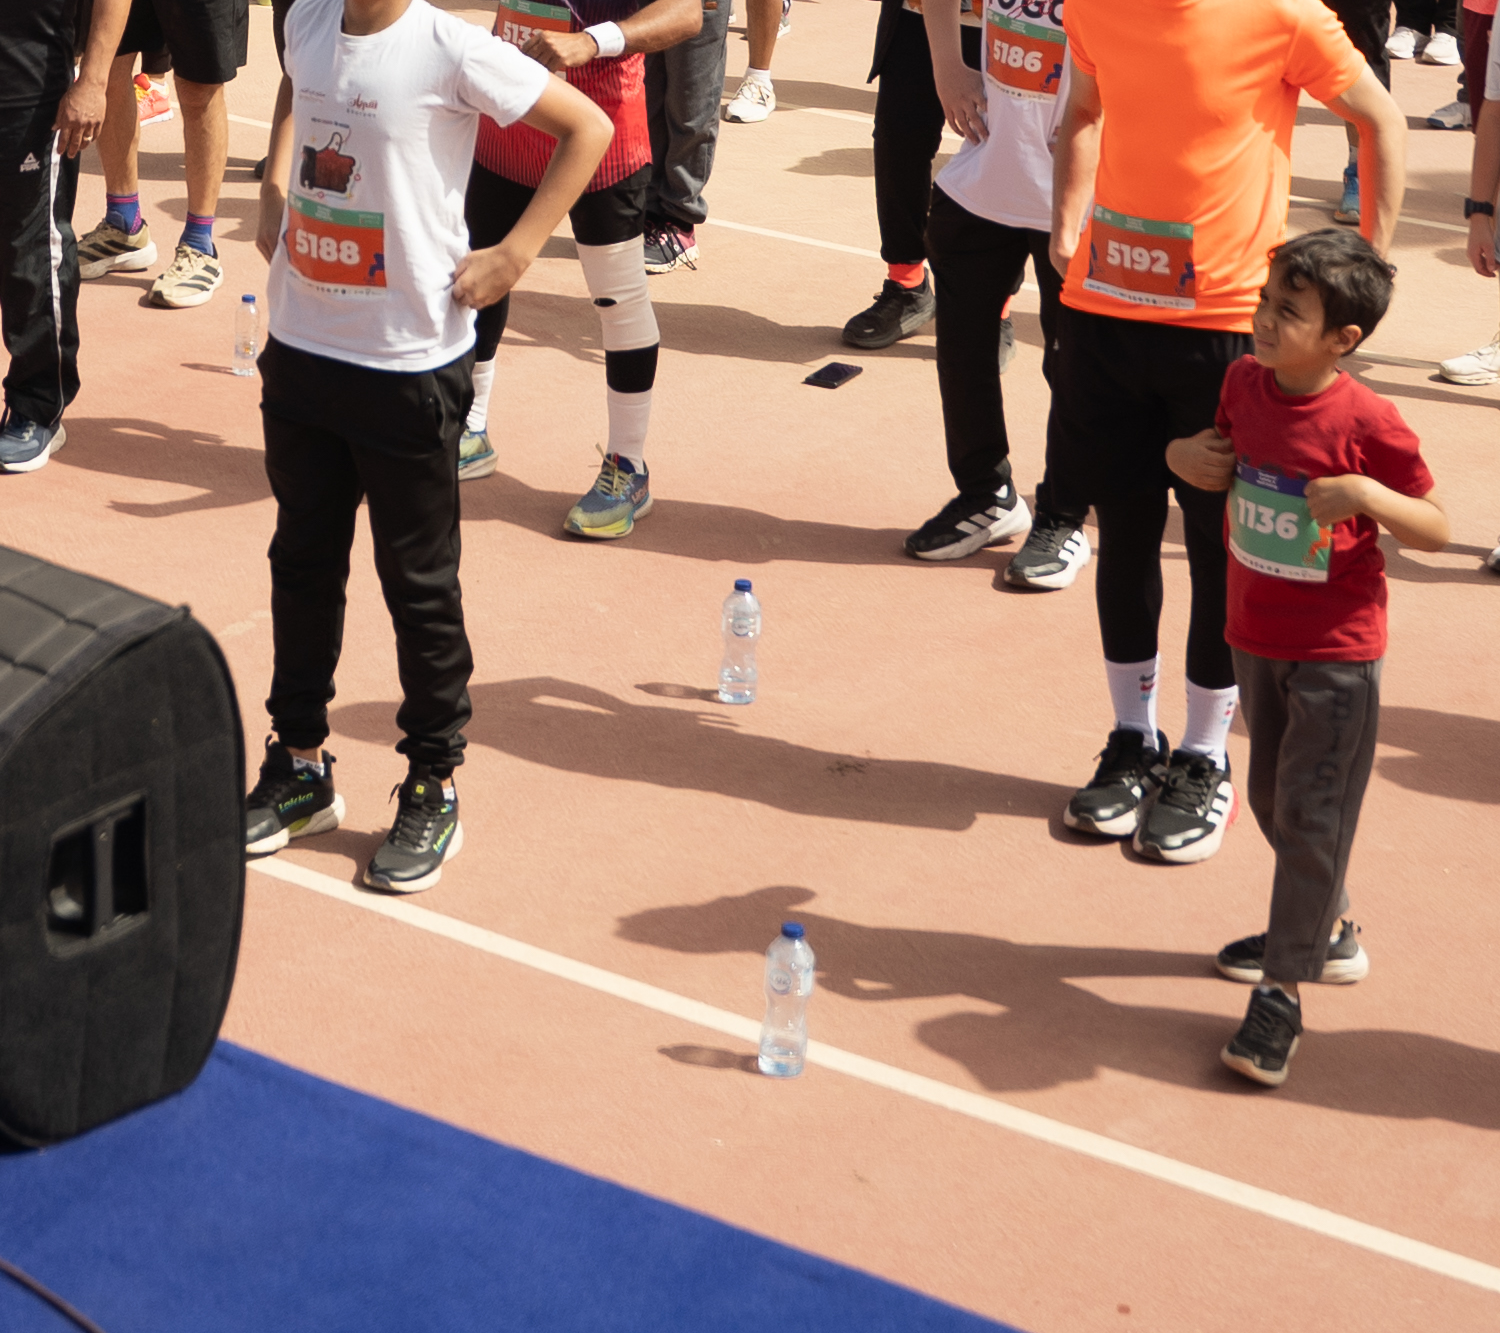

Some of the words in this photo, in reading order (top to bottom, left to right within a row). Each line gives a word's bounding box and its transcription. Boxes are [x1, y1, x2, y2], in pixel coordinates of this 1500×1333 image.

[993, 39, 1043, 73] 5186
[295, 228, 361, 265] 5188
[1106, 239, 1171, 276] 5192
[1237, 496, 1299, 541] 1136
